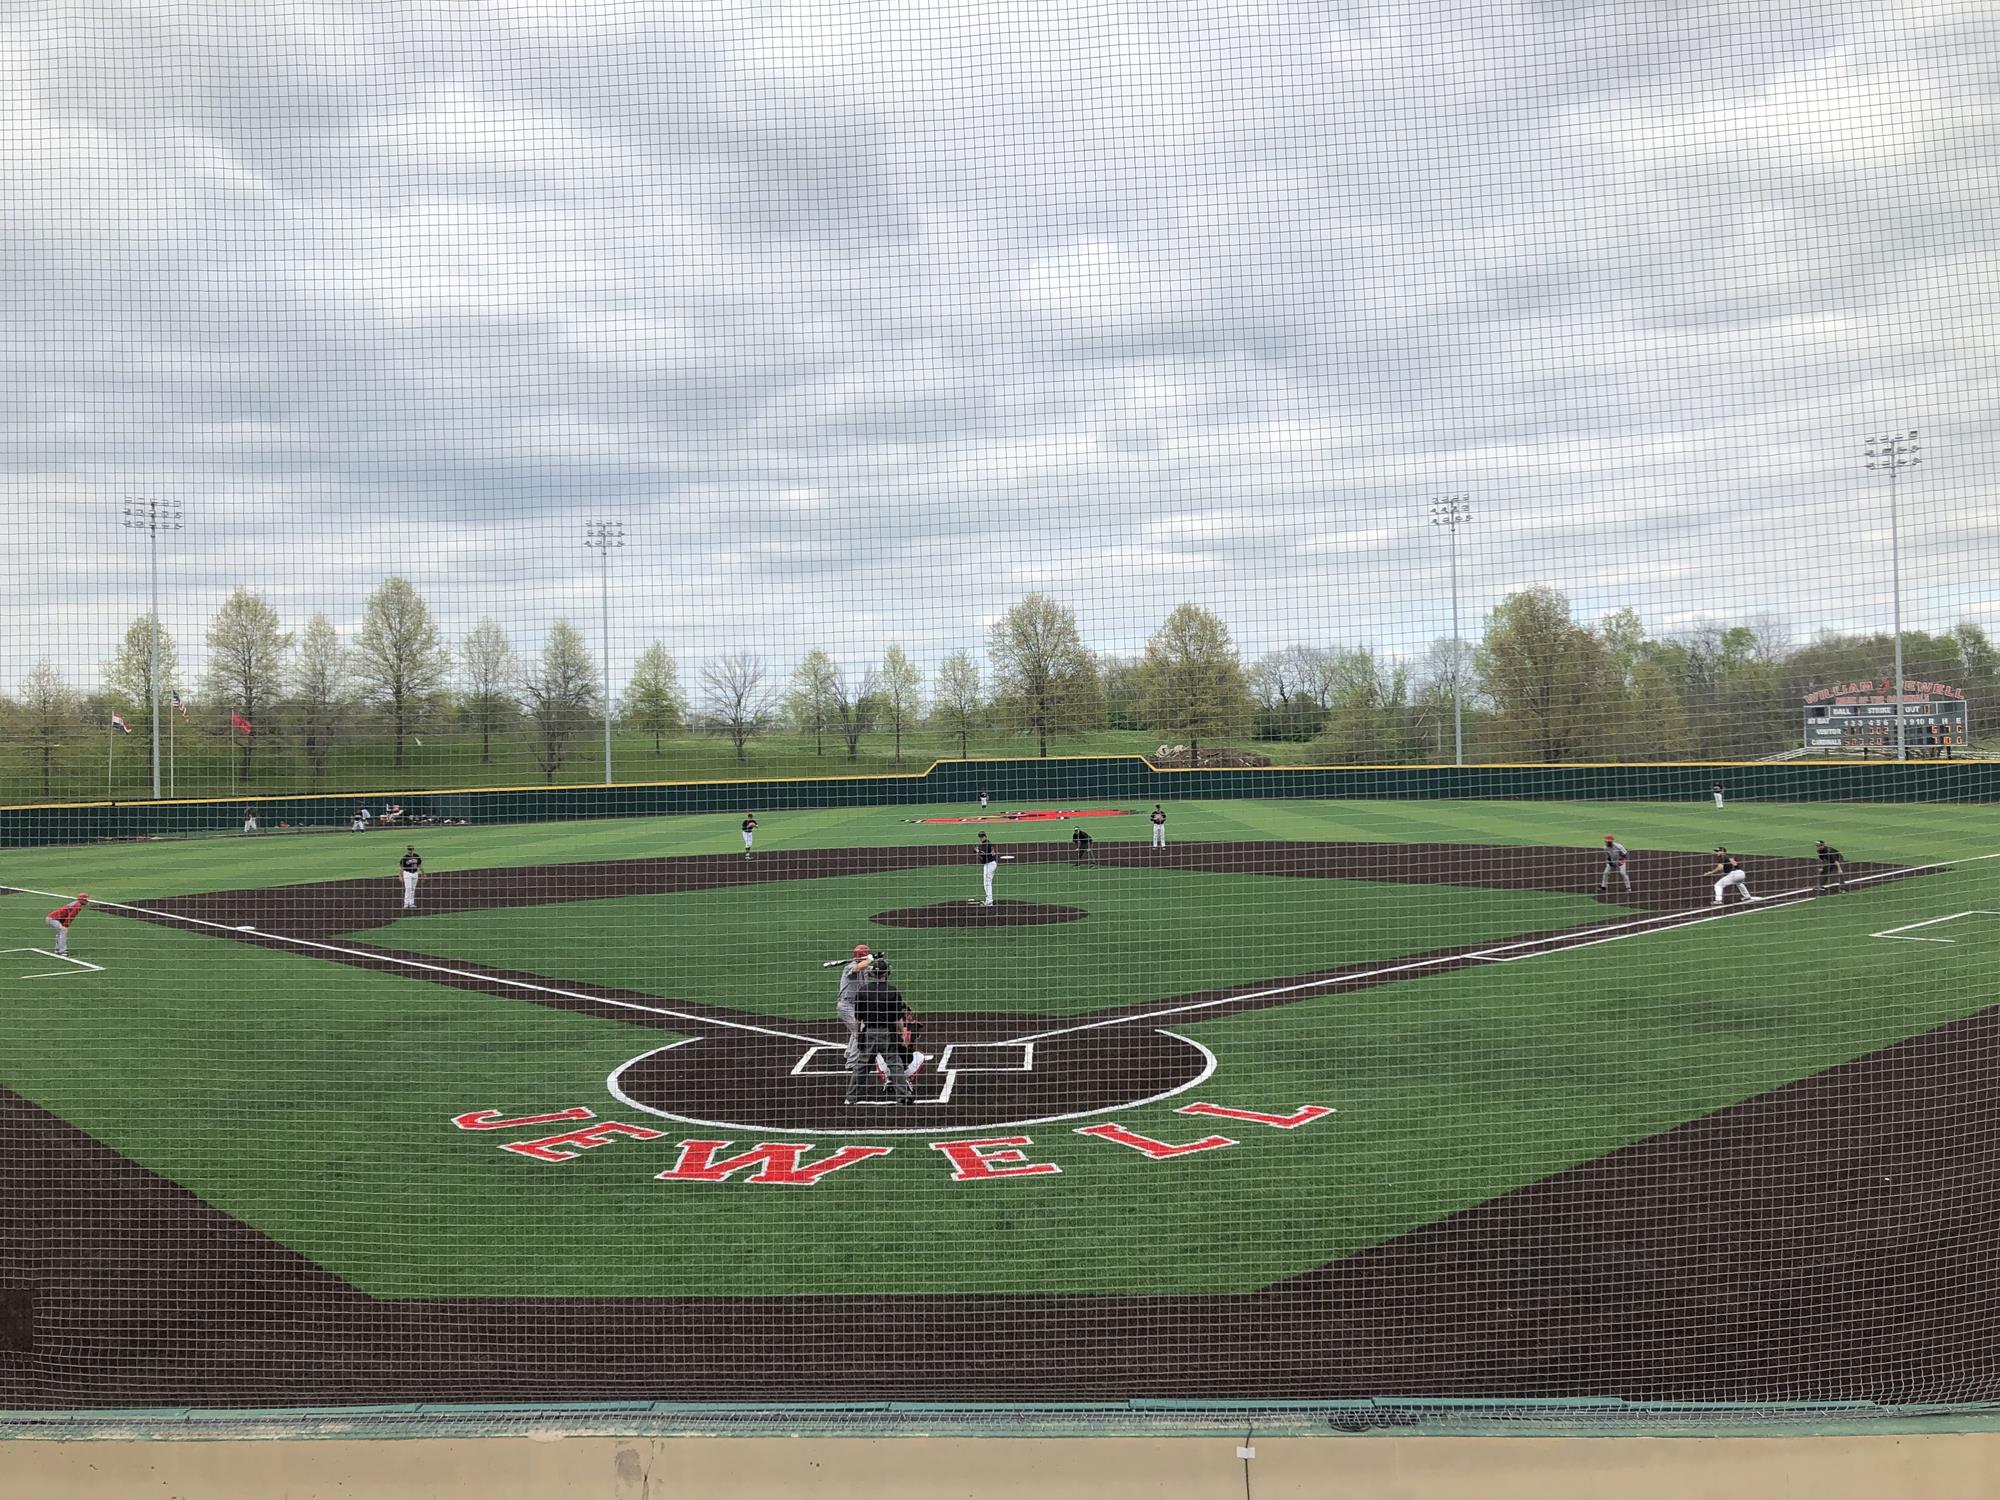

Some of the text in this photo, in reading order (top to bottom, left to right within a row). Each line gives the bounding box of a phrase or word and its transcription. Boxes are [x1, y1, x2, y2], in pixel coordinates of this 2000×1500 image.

[1802, 680, 1964, 704] WILLIAM EWELL
[450, 1101, 1336, 1186] JEWELL
